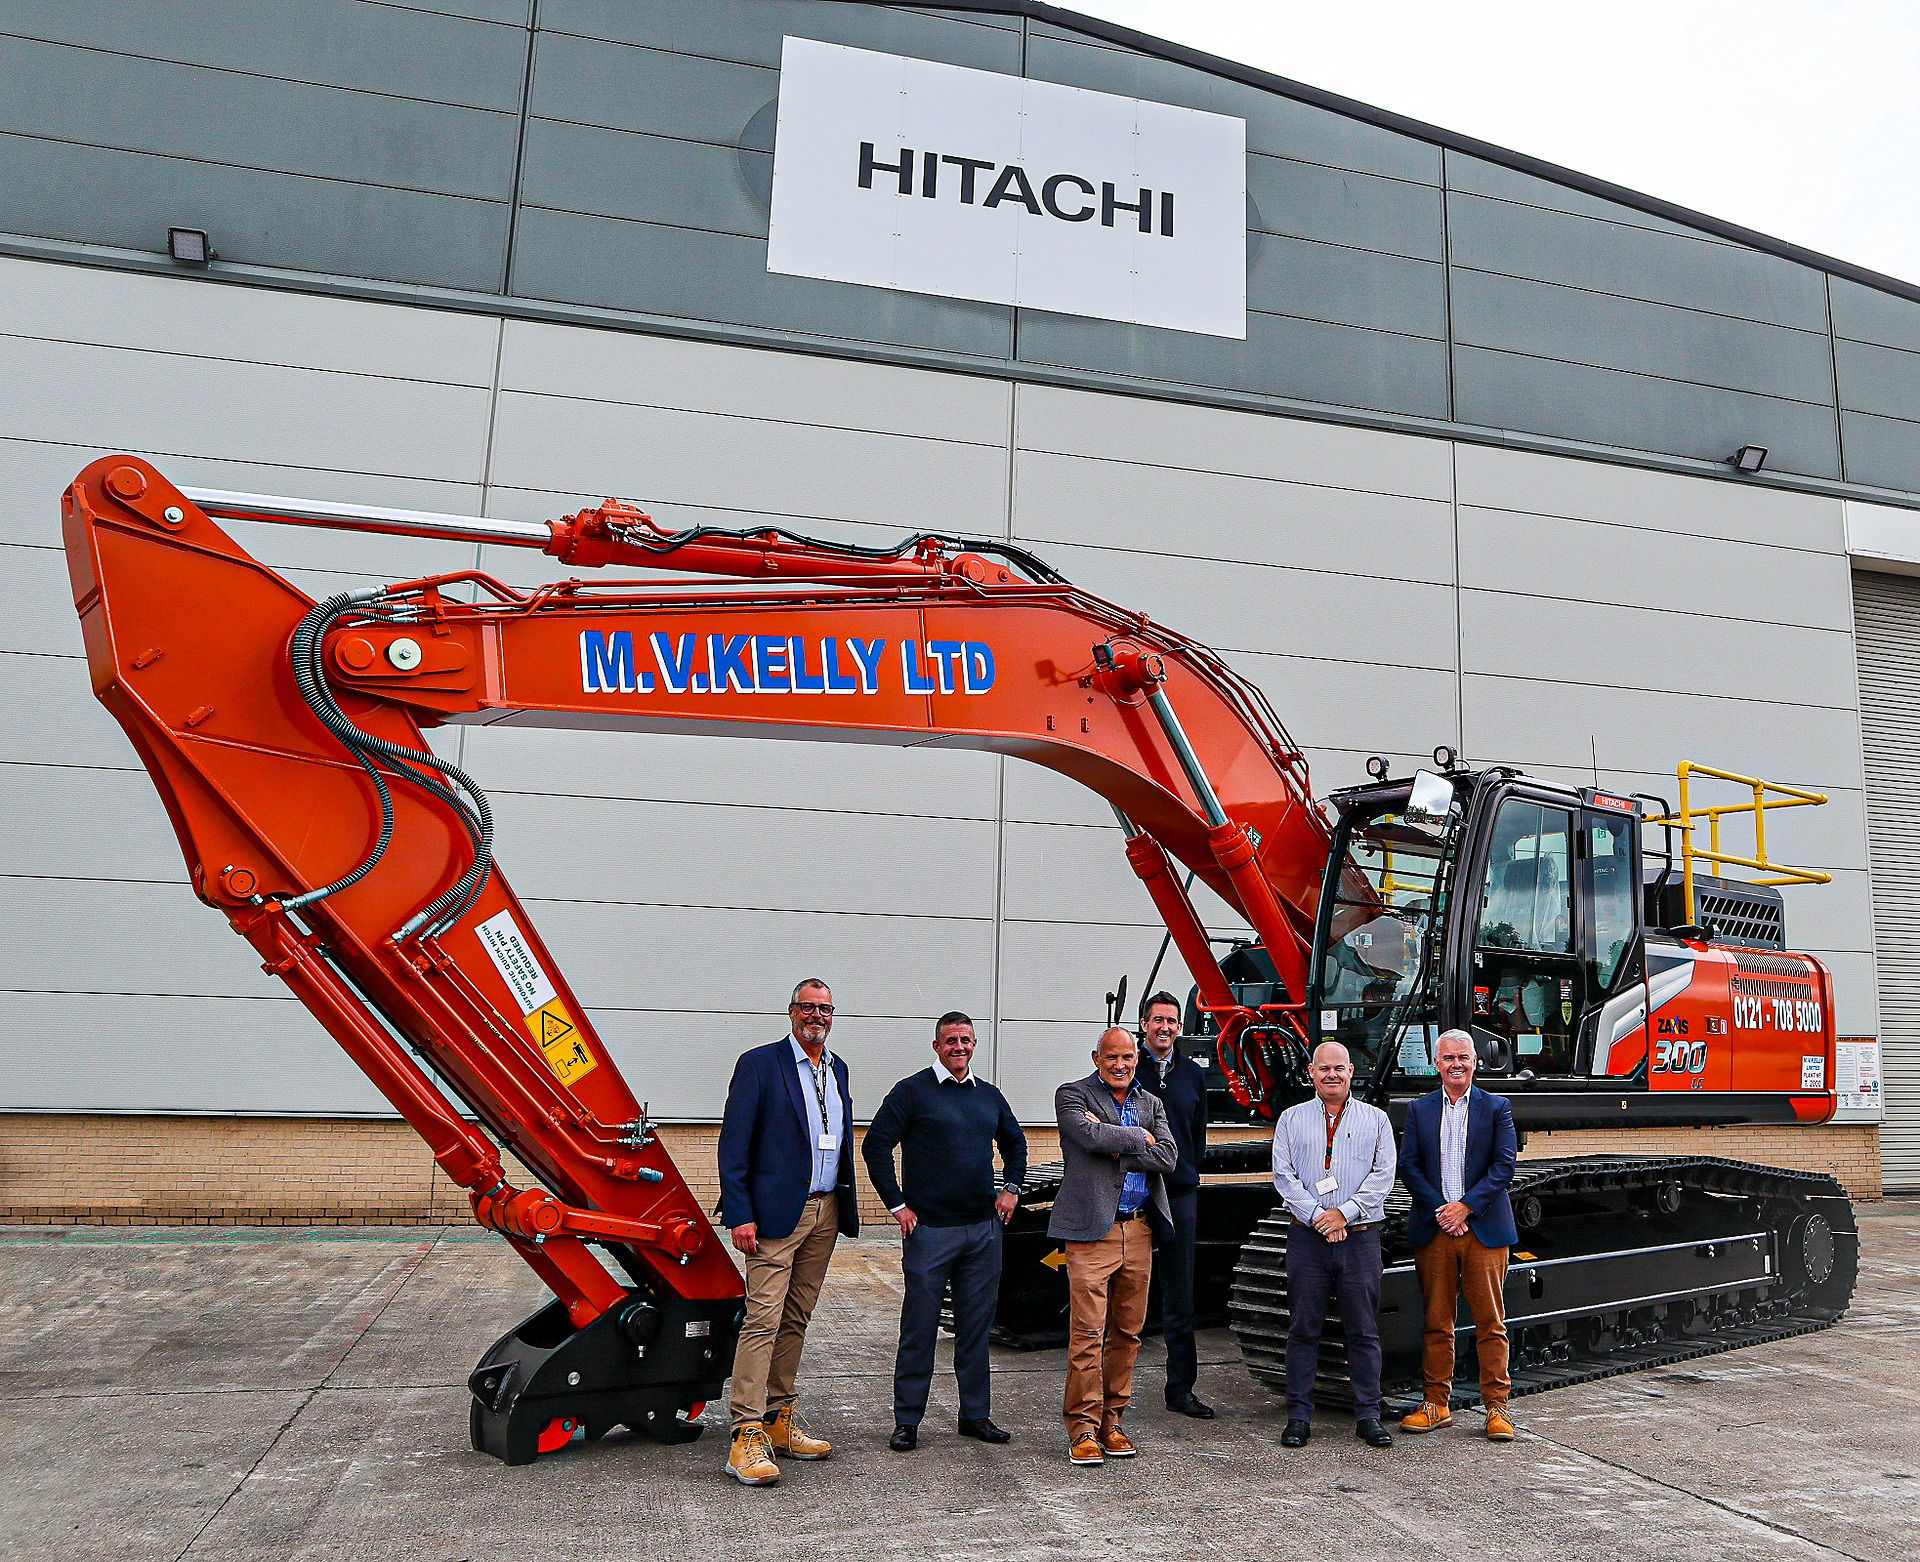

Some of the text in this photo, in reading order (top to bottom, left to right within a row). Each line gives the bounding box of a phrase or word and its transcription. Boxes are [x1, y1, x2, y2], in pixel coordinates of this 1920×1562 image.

[857, 141, 1174, 238] HITACHI
[580, 630, 997, 696] M.V.KELLY LTD
[1601, 797, 1626, 809] HITACHI
[481, 924, 535, 1010] AUTOMATIC QUICK HITCH
[494, 929, 537, 996] NO SAFETY PIN
[509, 935, 539, 980] REQUIRED
[1657, 1016, 1689, 1035] ZAXIS
[1733, 995, 1763, 1030] 0121
[1771, 998, 1794, 1031] 708
[1795, 1000, 1822, 1033] 5000
[1651, 1040, 1709, 1074] 300
[1691, 1077, 1705, 1090] LC
